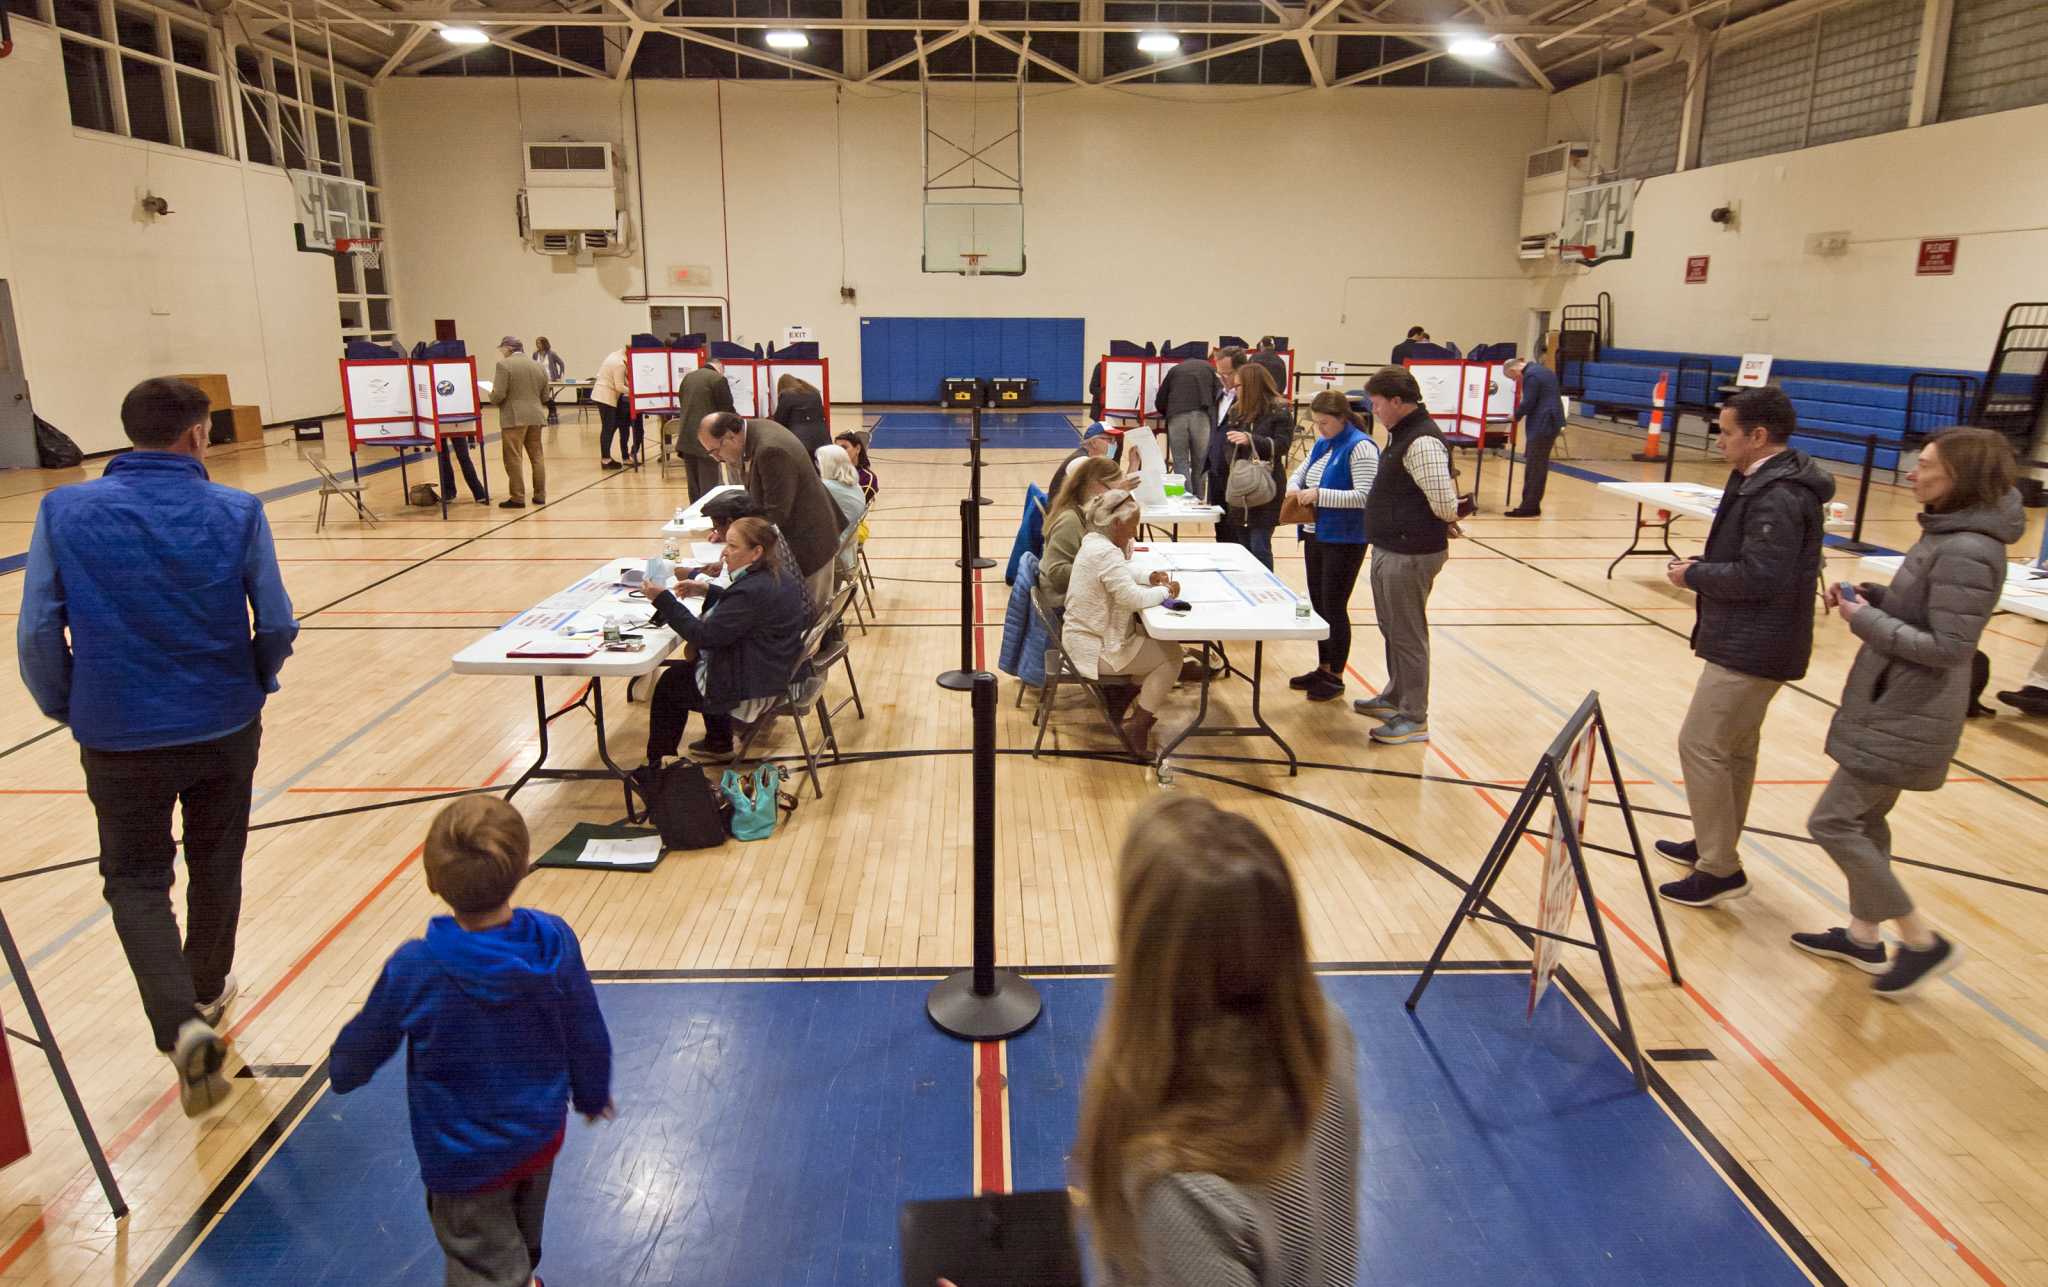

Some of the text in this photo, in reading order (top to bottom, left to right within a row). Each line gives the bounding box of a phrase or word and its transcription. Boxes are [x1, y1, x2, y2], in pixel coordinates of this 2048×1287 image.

[788, 331, 807, 339] EXIT
[1744, 360, 1765, 369] EXIT
[1320, 366, 1339, 374] EXIT
